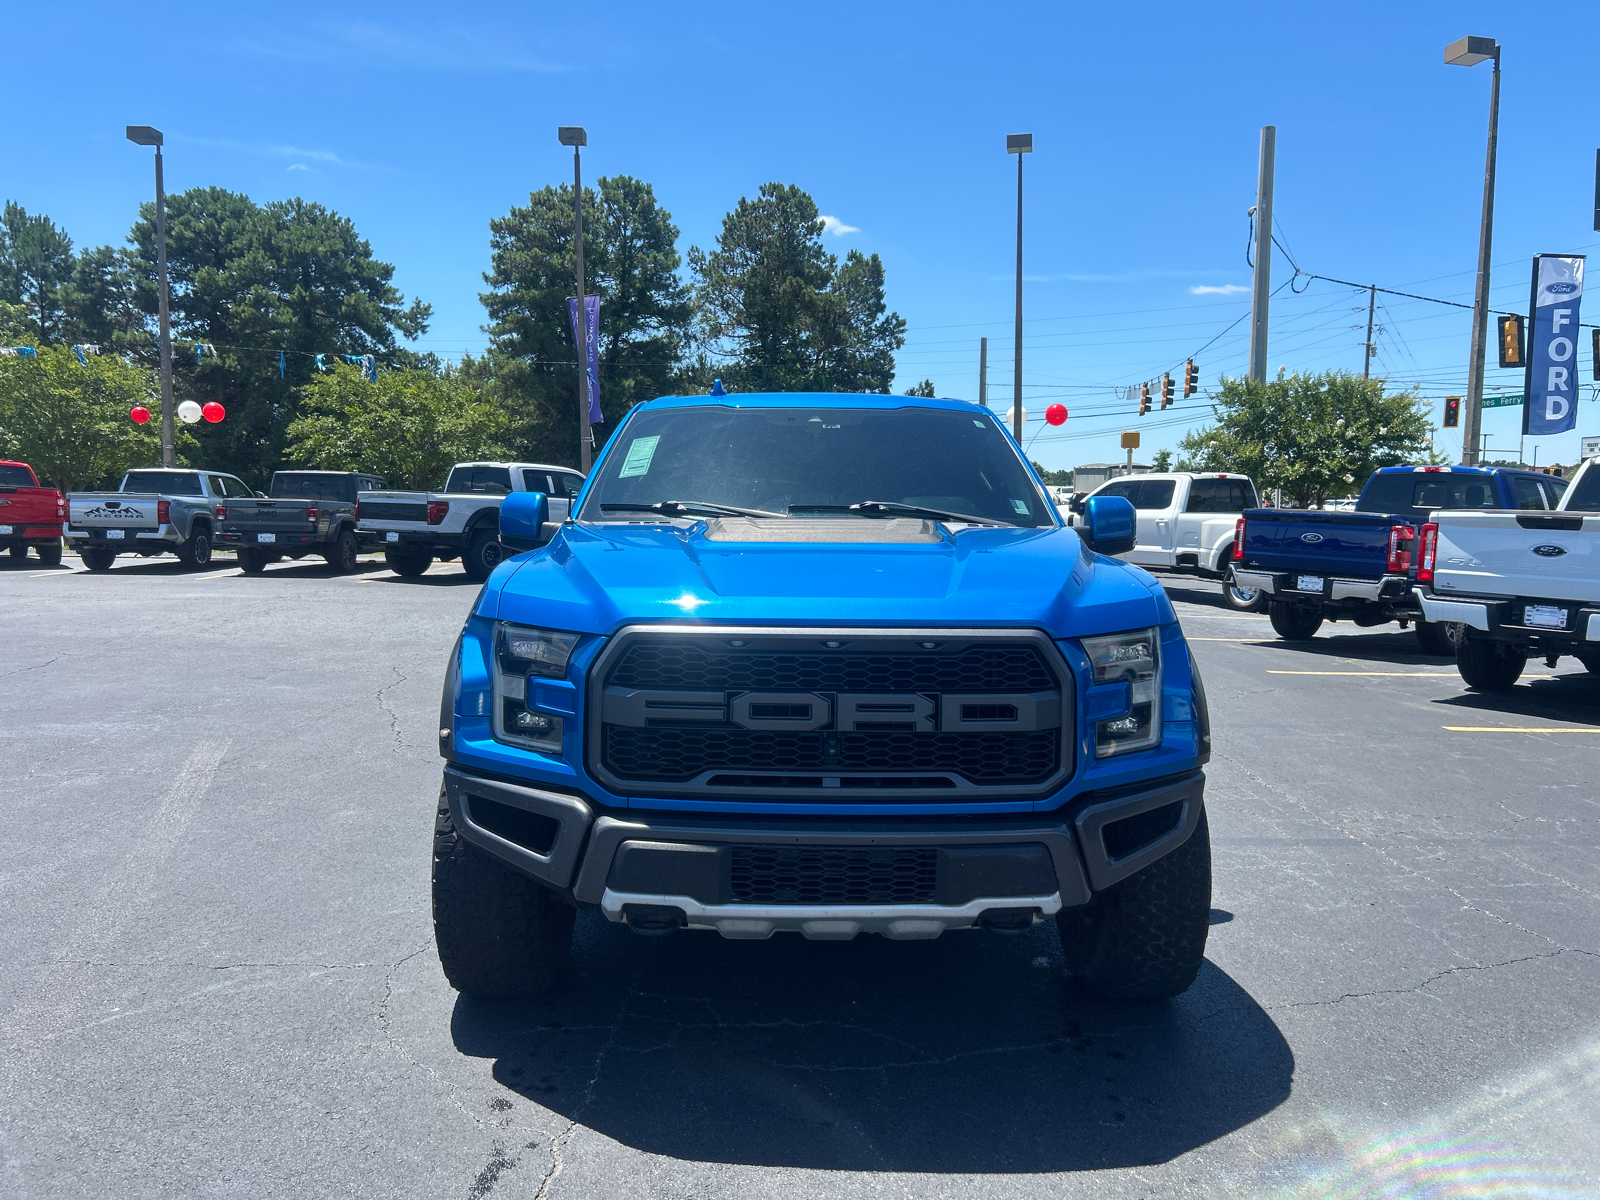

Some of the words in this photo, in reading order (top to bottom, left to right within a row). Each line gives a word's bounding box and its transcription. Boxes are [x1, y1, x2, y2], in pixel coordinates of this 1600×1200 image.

[1545, 308, 1573, 420] FORD
[1481, 399, 1495, 407] nes
[1500, 397, 1522, 406] Ferry
[255, 509, 277, 518] Jeep
[365, 506, 418, 516] FORD
[602, 689, 1062, 732] FORD
